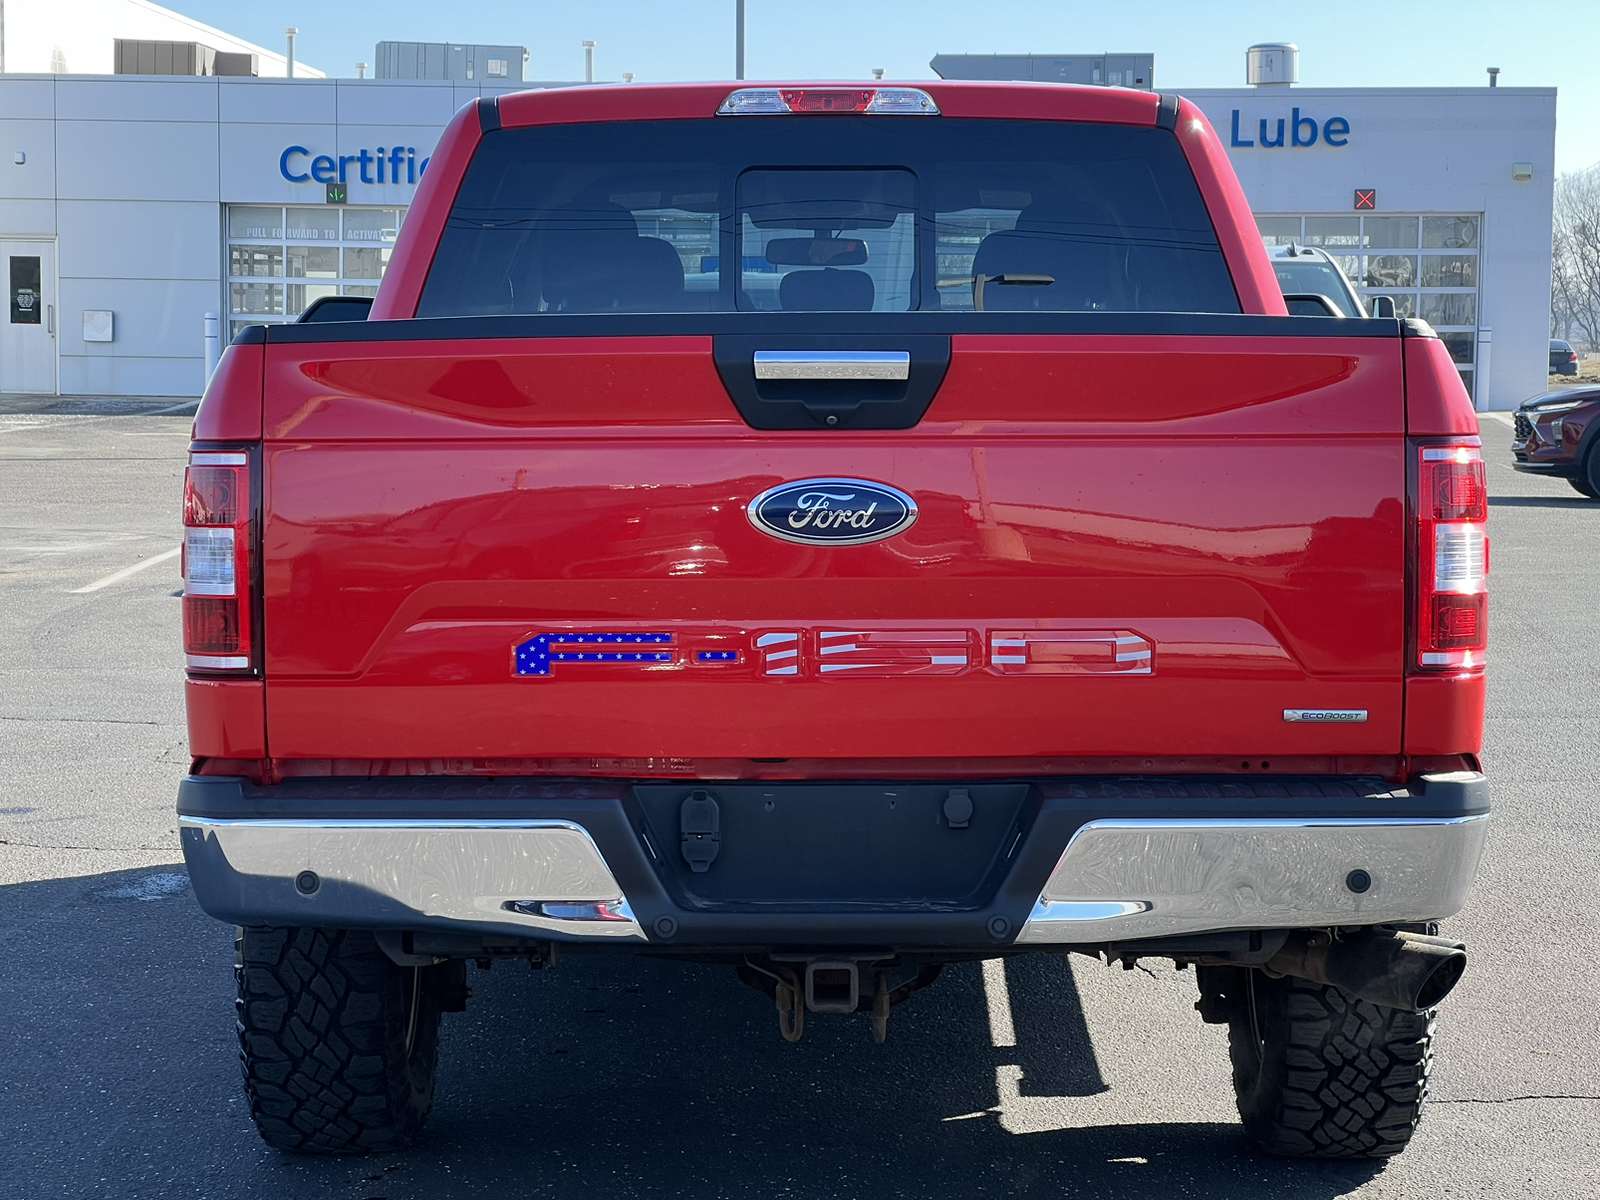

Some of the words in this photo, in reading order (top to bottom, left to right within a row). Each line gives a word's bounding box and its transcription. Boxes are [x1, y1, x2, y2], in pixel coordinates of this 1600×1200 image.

[1230, 107, 1350, 148] Lube
[246, 227, 267, 238] PULL
[272, 228, 319, 239] FORWARD
[324, 229, 335, 240] TO
[788, 492, 877, 529] Ford
[511, 630, 1153, 676] F-150
